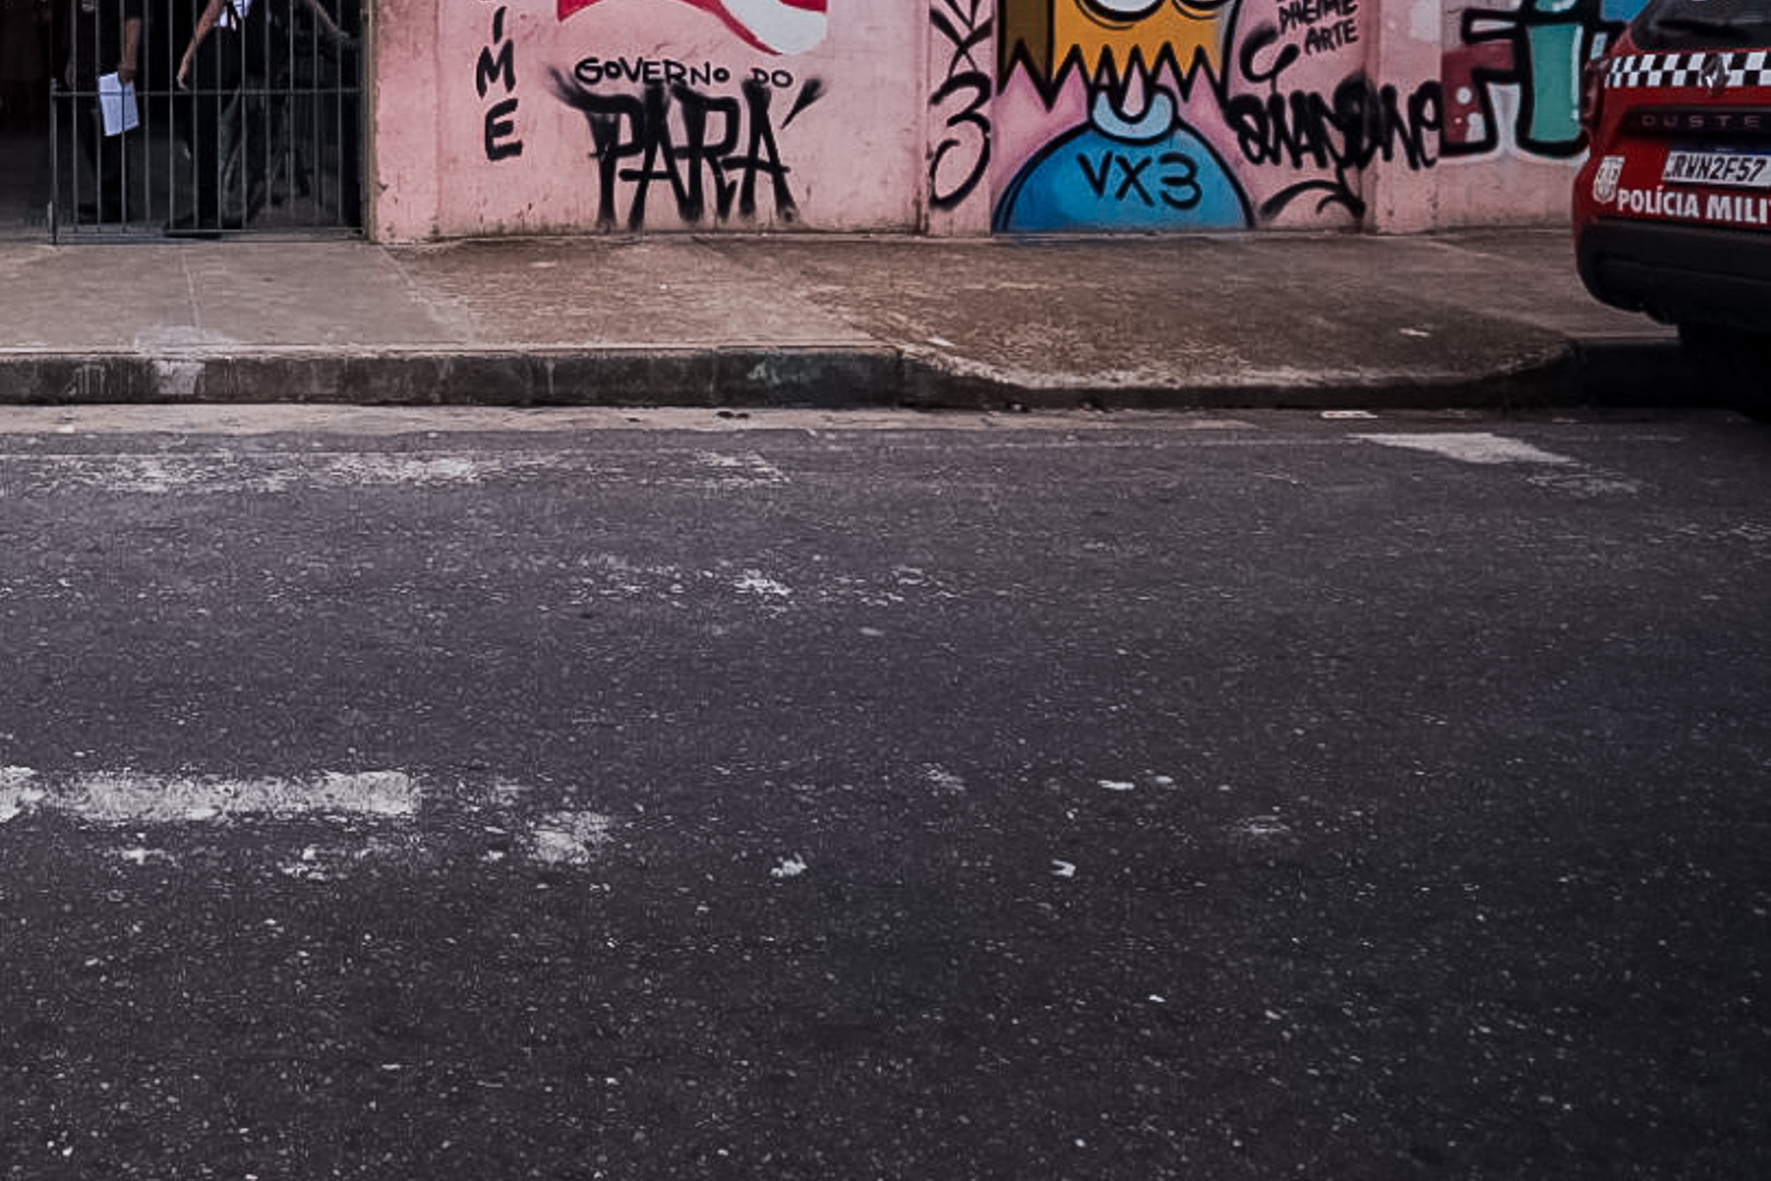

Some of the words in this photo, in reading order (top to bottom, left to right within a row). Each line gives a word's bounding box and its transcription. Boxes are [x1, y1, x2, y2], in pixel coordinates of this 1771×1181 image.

[1303, 18, 1359, 56] ARTE
[574, 56, 731, 86] GOVERNO
[749, 67, 794, 88] DO
[548, 71, 828, 230] PARÁ
[1076, 153, 1203, 210] VX3
[1617, 183, 1699, 219] POLÍCIA
[1705, 194, 1771, 225] MILI
